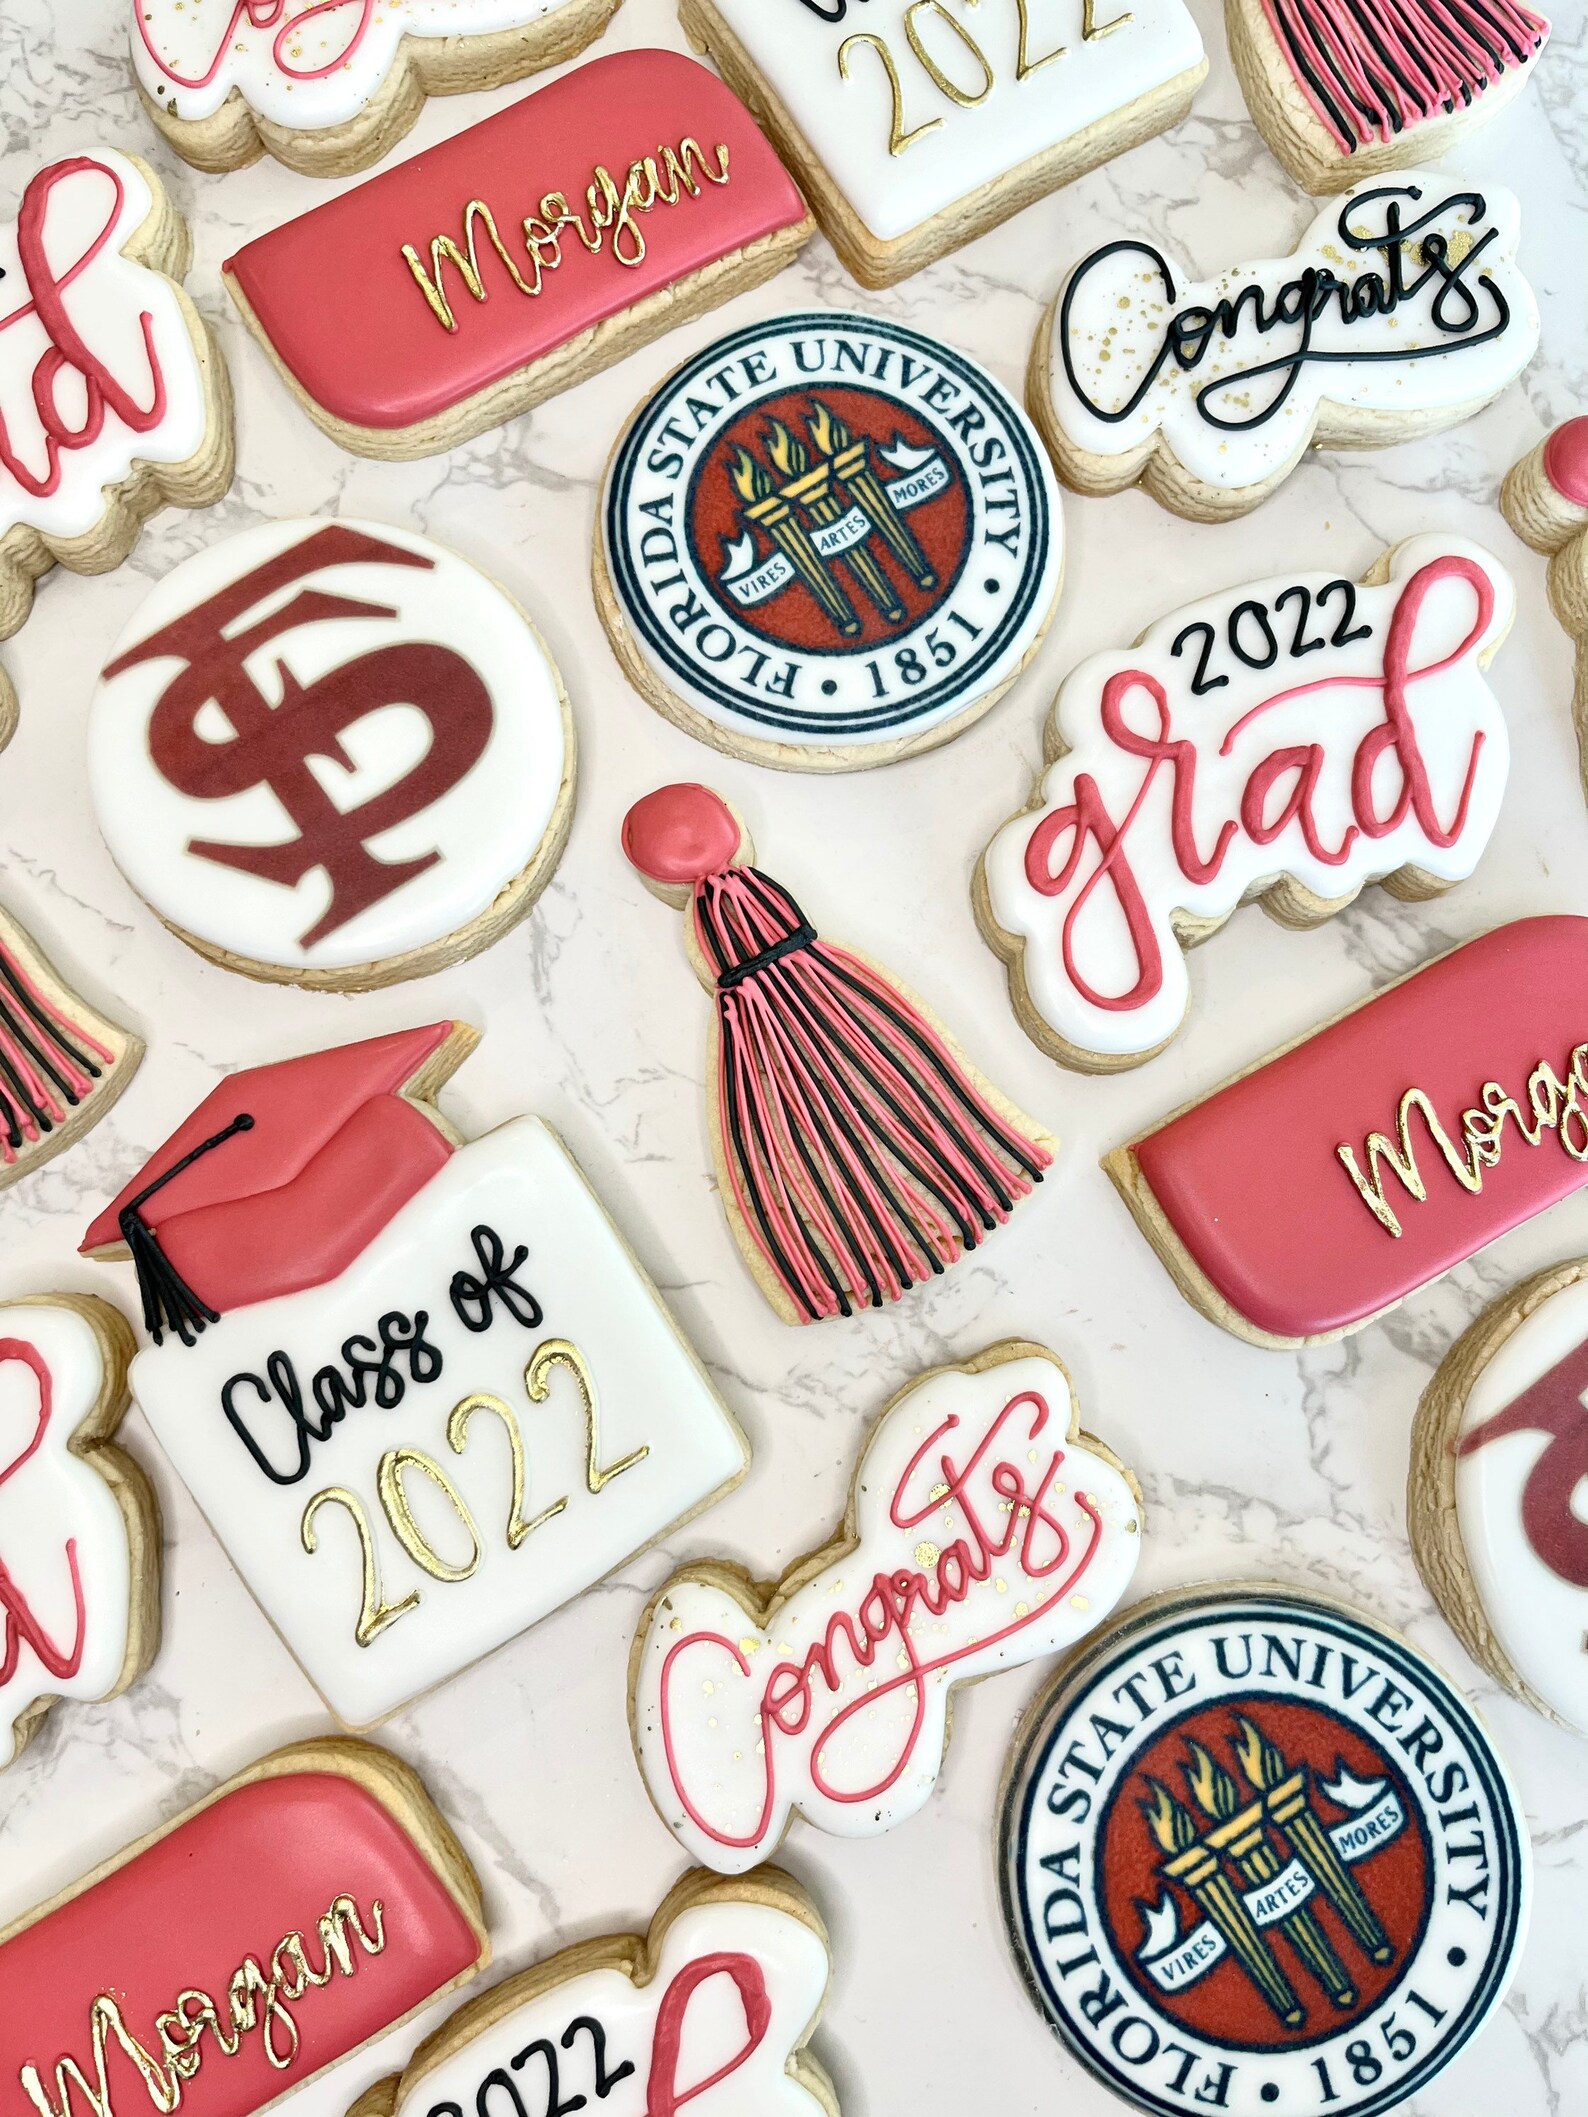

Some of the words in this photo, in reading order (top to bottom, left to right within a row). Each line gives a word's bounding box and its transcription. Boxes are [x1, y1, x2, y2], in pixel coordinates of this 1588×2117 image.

[400, 137, 730, 334] Morgan
[1060, 186, 1510, 432] Congrats
[648, 350, 777, 480] STATE
[789, 338, 1022, 560] UNIVERSITY
[893, 467, 946, 504] MORES
[640, 492, 803, 699] FLORIDA
[738, 562, 787, 600] VIRES
[819, 514, 867, 552] ARTES
[865, 609, 984, 698] 1851
[1170, 578, 1373, 696] 2022
[1024, 555, 1486, 1012] grad
[221, 1311, 443, 1486] Class
[449, 1224, 544, 1330] of
[300, 1338, 650, 1650] 2022
[660, 1391, 1102, 1848] Congrats
[1048, 1650, 1197, 1826] STATE
[1210, 1634, 1491, 1923] UNIVERSITY
[1256, 1871, 1309, 1918] ARTES
[1338, 1805, 1399, 1854] MORES
[1041, 1844, 1239, 2108] FLORIDA
[1161, 1934, 1217, 1982] VIRES
[427, 2016, 635, 2117] 022
[1310, 1990, 1448, 2105] 1851
